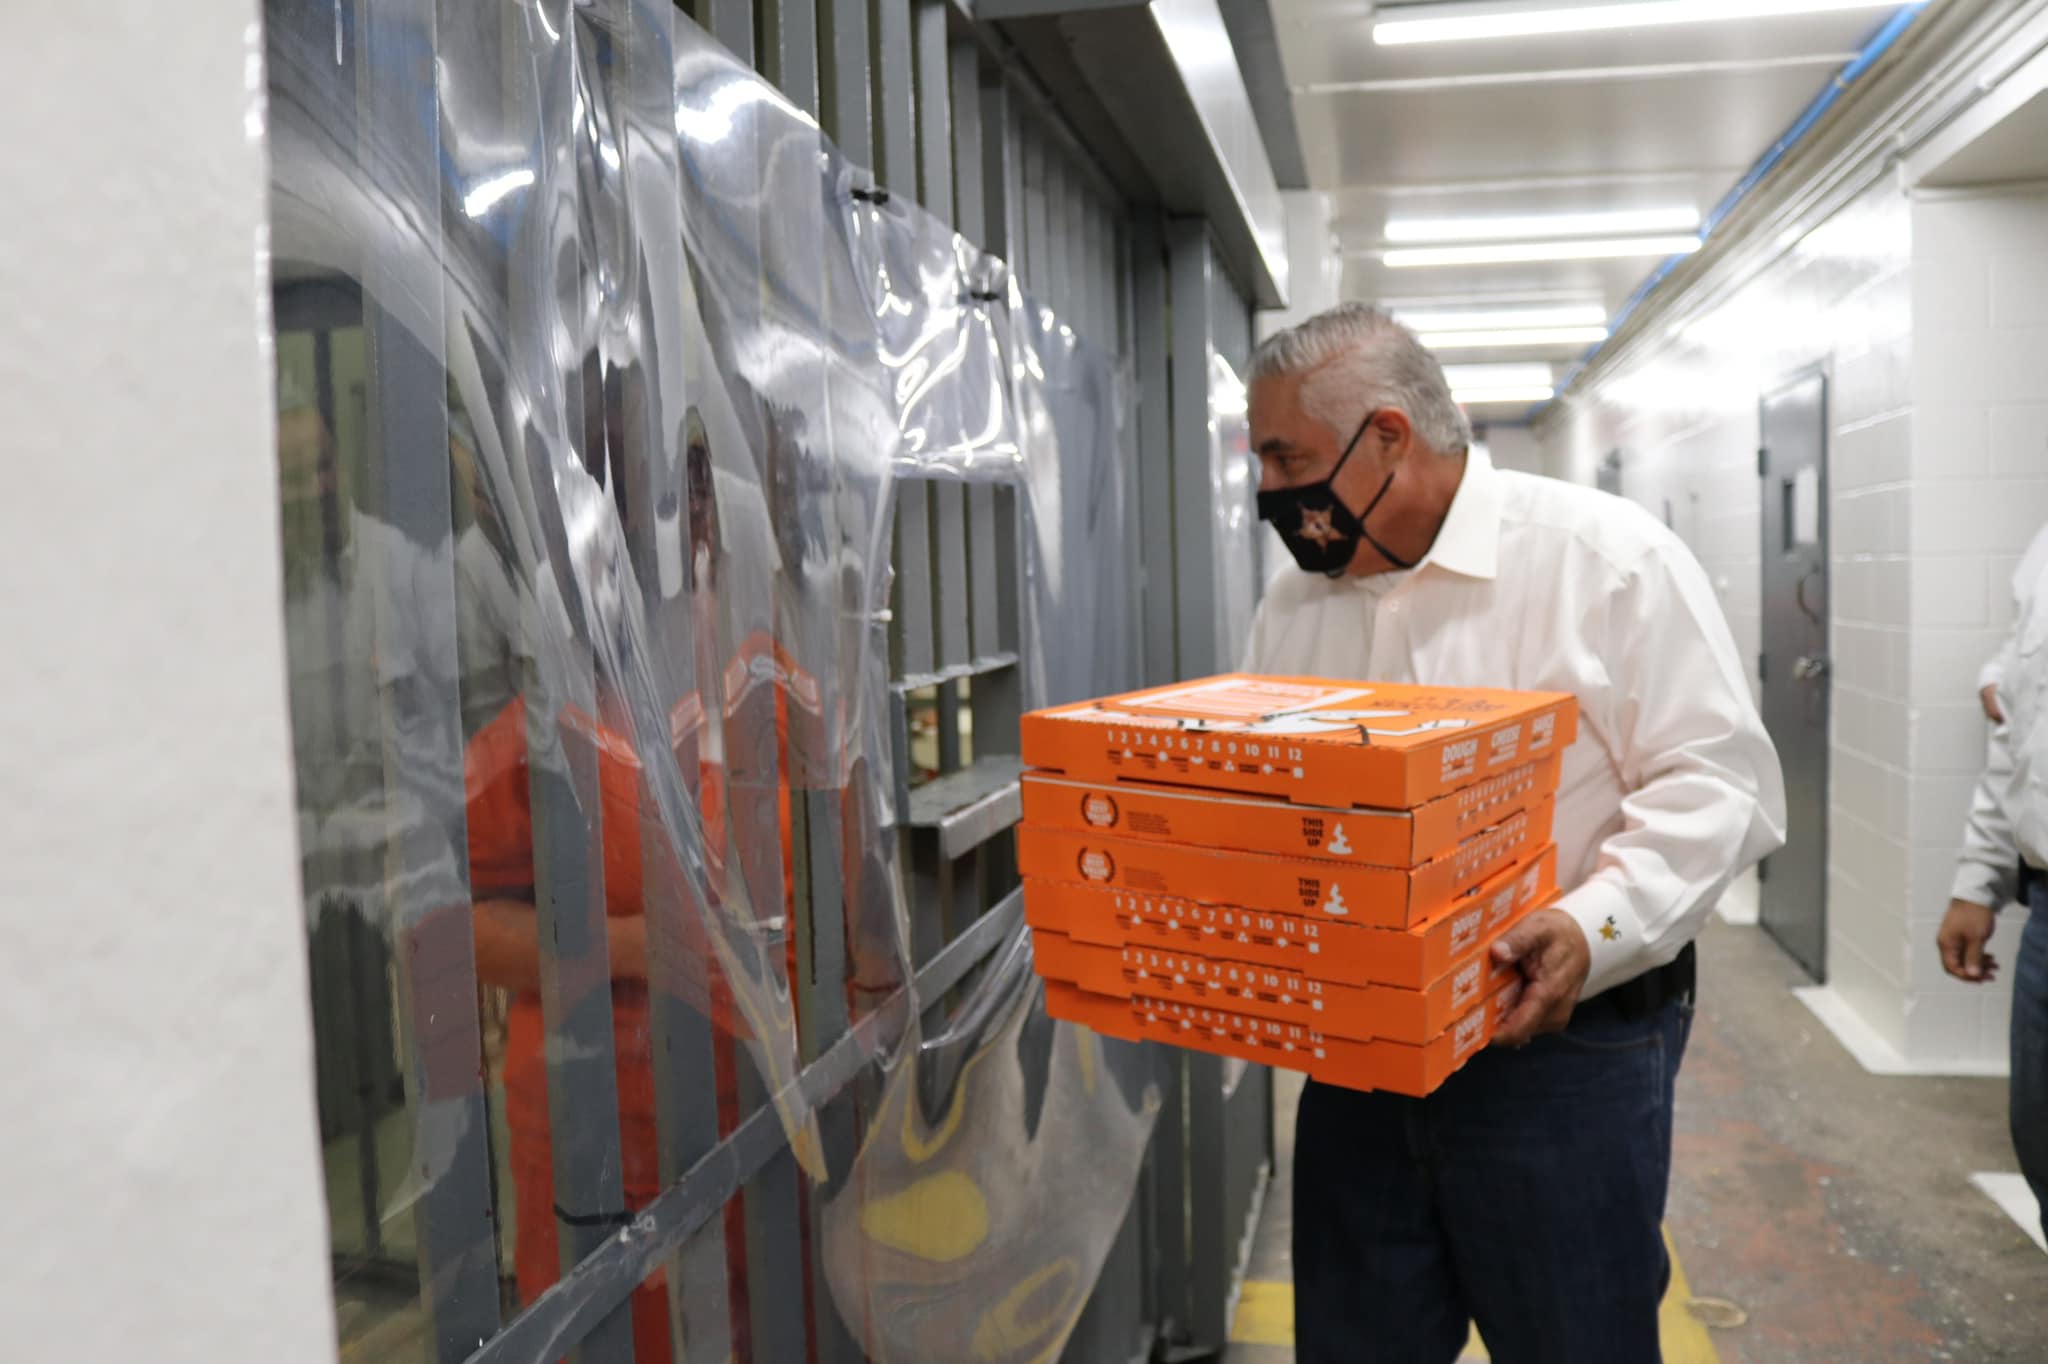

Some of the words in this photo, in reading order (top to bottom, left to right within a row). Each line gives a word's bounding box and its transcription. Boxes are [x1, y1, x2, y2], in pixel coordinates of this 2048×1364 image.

[1108, 730, 1113, 742] 1
[1121, 731, 1128, 743] 2
[1135, 733, 1142, 745] 3
[1150, 734, 1158, 746] 4
[1166, 736, 1173, 748] 5
[1180, 737, 1188, 749] 6
[1197, 739, 1203, 751] 7
[1212, 740, 1220, 753] 8
[1228, 742, 1237, 754] 9
[1245, 744, 1260, 757] 10
[1268, 746, 1280, 759] 11
[1289, 748, 1303, 761] 12
[1442, 738, 1479, 764] DOUGH
[1302, 817, 1324, 827] THIS
[1303, 827, 1323, 837] SIDE
[1307, 838, 1320, 847] UP
[1298, 877, 1320, 887] THIS
[1298, 887, 1320, 897] SIDE
[1303, 898, 1316, 907] UP
[1115, 896, 1121, 908] 1
[1129, 898, 1136, 910] 2
[1144, 900, 1152, 912] 3
[1160, 903, 1168, 914] 4
[1176, 905, 1184, 917] 5
[1192, 908, 1200, 919] 6
[1208, 910, 1215, 922] 7
[1224, 912, 1233, 924] 8
[1242, 914, 1250, 927] 9
[1259, 917, 1274, 930] 10
[1283, 921, 1294, 934] 11
[1304, 924, 1318, 937] 12
[1122, 950, 1128, 961] 1
[1136, 952, 1143, 964] 2
[1151, 954, 1158, 966] 3
[1166, 957, 1174, 969] 4
[1182, 960, 1189, 972] 5
[1197, 963, 1206, 974] 6
[1214, 965, 1221, 977] 7
[1230, 968, 1238, 980] 8
[1246, 971, 1255, 983] 9
[1264, 973, 1278, 987] 10
[1287, 977, 1299, 990] 11
[1308, 981, 1322, 994] 12
